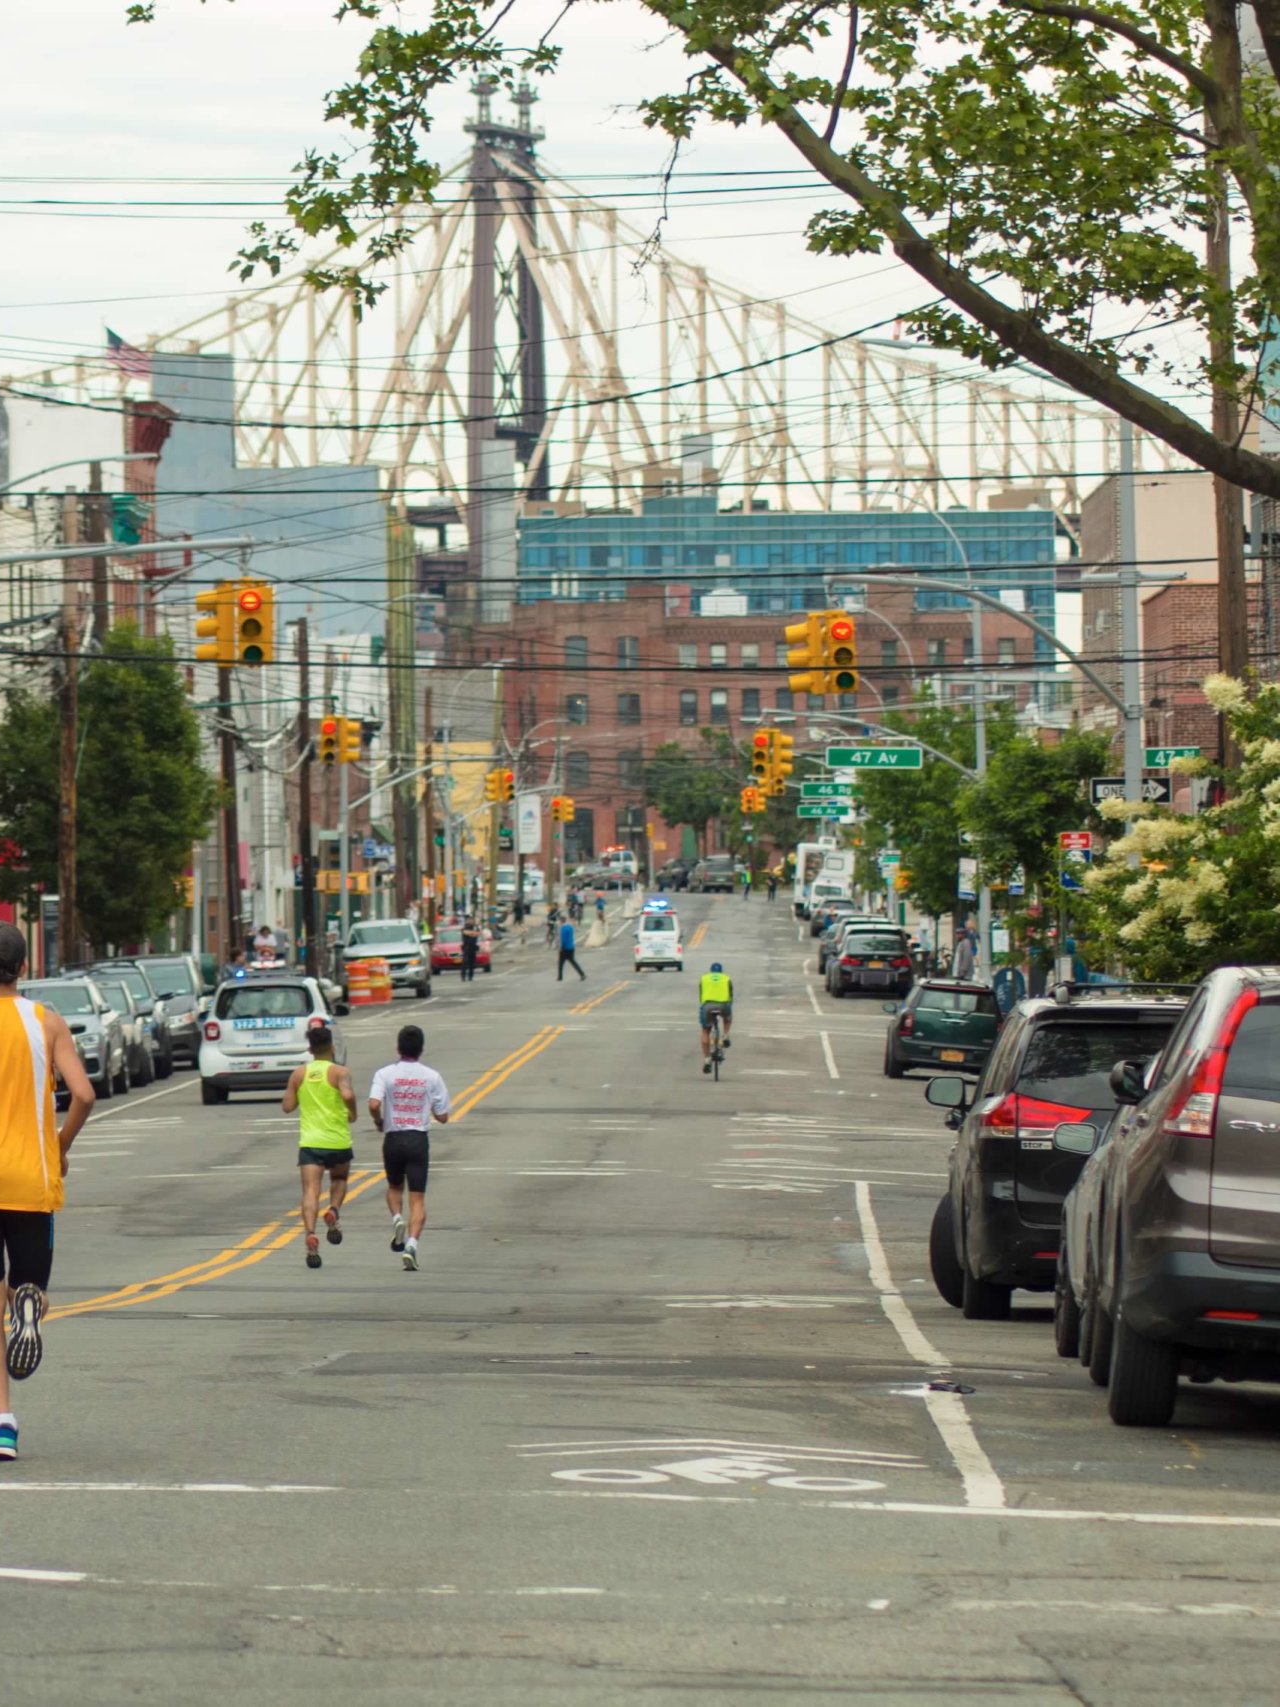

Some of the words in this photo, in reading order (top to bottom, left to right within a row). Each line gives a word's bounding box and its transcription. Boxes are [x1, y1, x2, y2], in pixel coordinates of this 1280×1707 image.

[851, 752, 872, 764] 47
[878, 752, 898, 764] Av
[1155, 751, 1175, 766] 47
[818, 785, 833, 794] 46
[1102, 786, 1125, 796] ONE
[261, 1018, 295, 1029] POLICE
